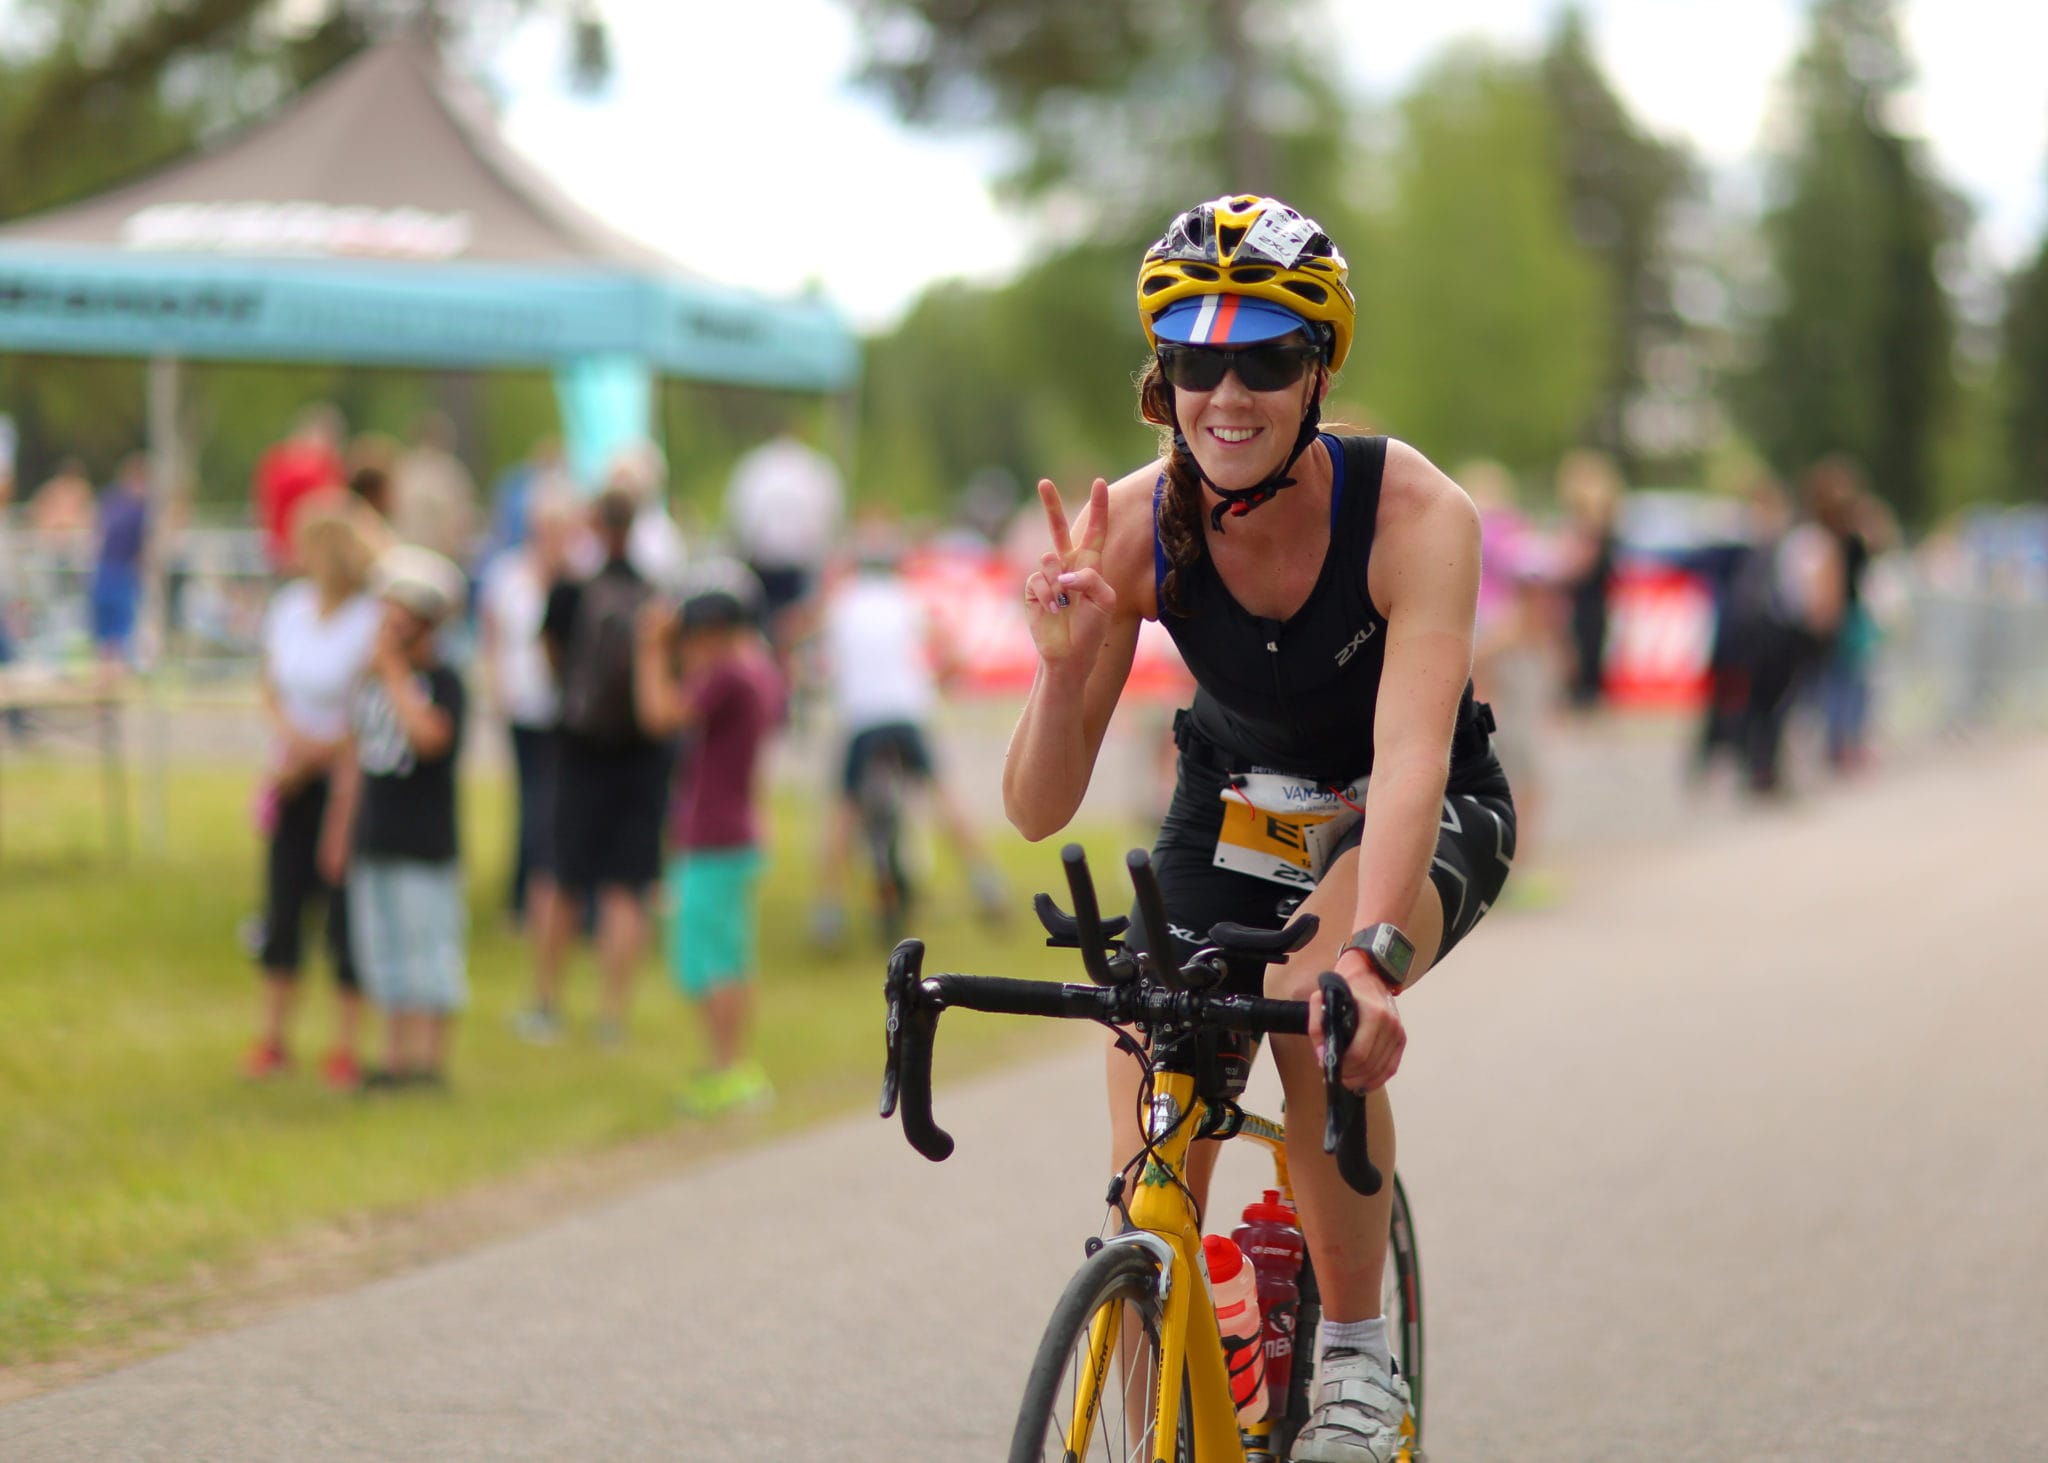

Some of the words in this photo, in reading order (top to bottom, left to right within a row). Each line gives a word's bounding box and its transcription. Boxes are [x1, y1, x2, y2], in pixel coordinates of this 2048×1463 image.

[1334, 621, 1377, 667] 2XU
[1272, 863, 1317, 886] 2X
[1166, 922, 1211, 945] XU
